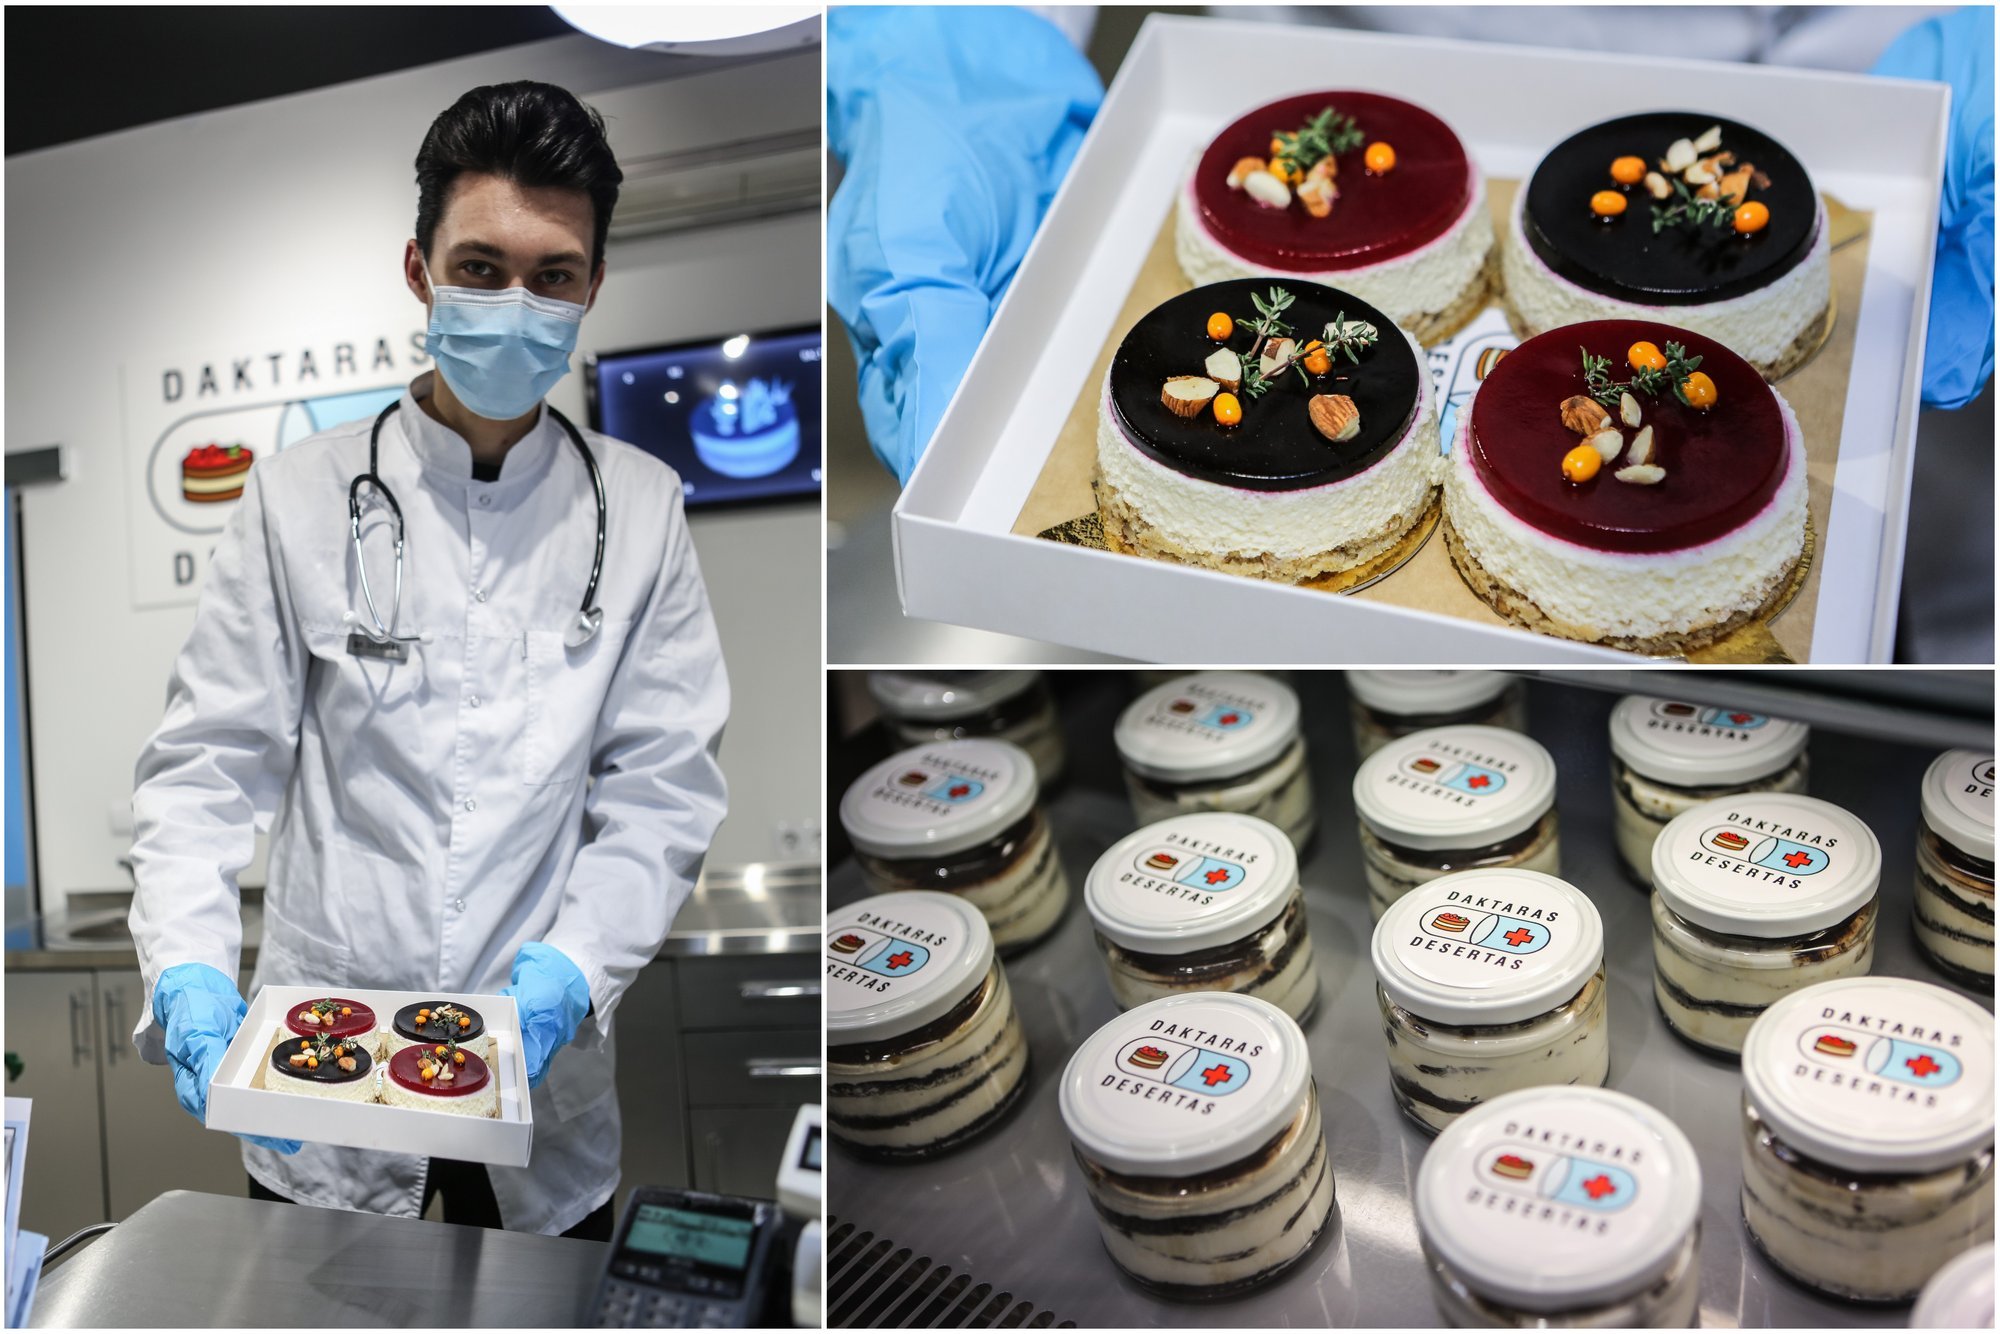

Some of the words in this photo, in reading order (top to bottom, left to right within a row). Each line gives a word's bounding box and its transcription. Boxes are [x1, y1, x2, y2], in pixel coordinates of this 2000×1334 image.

[163, 332, 430, 401] DAKTARAS
[1166, 832, 1258, 865] DAKTARAS
[1727, 812, 1838, 849] DAKTARAS
[1120, 872, 1214, 906] DESERTAS
[1690, 851, 1802, 890] DESERTAS
[1447, 891, 1559, 923] DAKTARAS
[857, 912, 947, 947] DAKTARAS
[1409, 936, 1523, 971] DESERTAS
[1149, 1019, 1263, 1058] DAKTARAS
[1821, 1006, 1963, 1047] DAKTARAS
[1100, 1074, 1217, 1116] DESERTAS
[1794, 1063, 1939, 1108] DESERTAS
[1504, 1121, 1643, 1163] DAKTARAS
